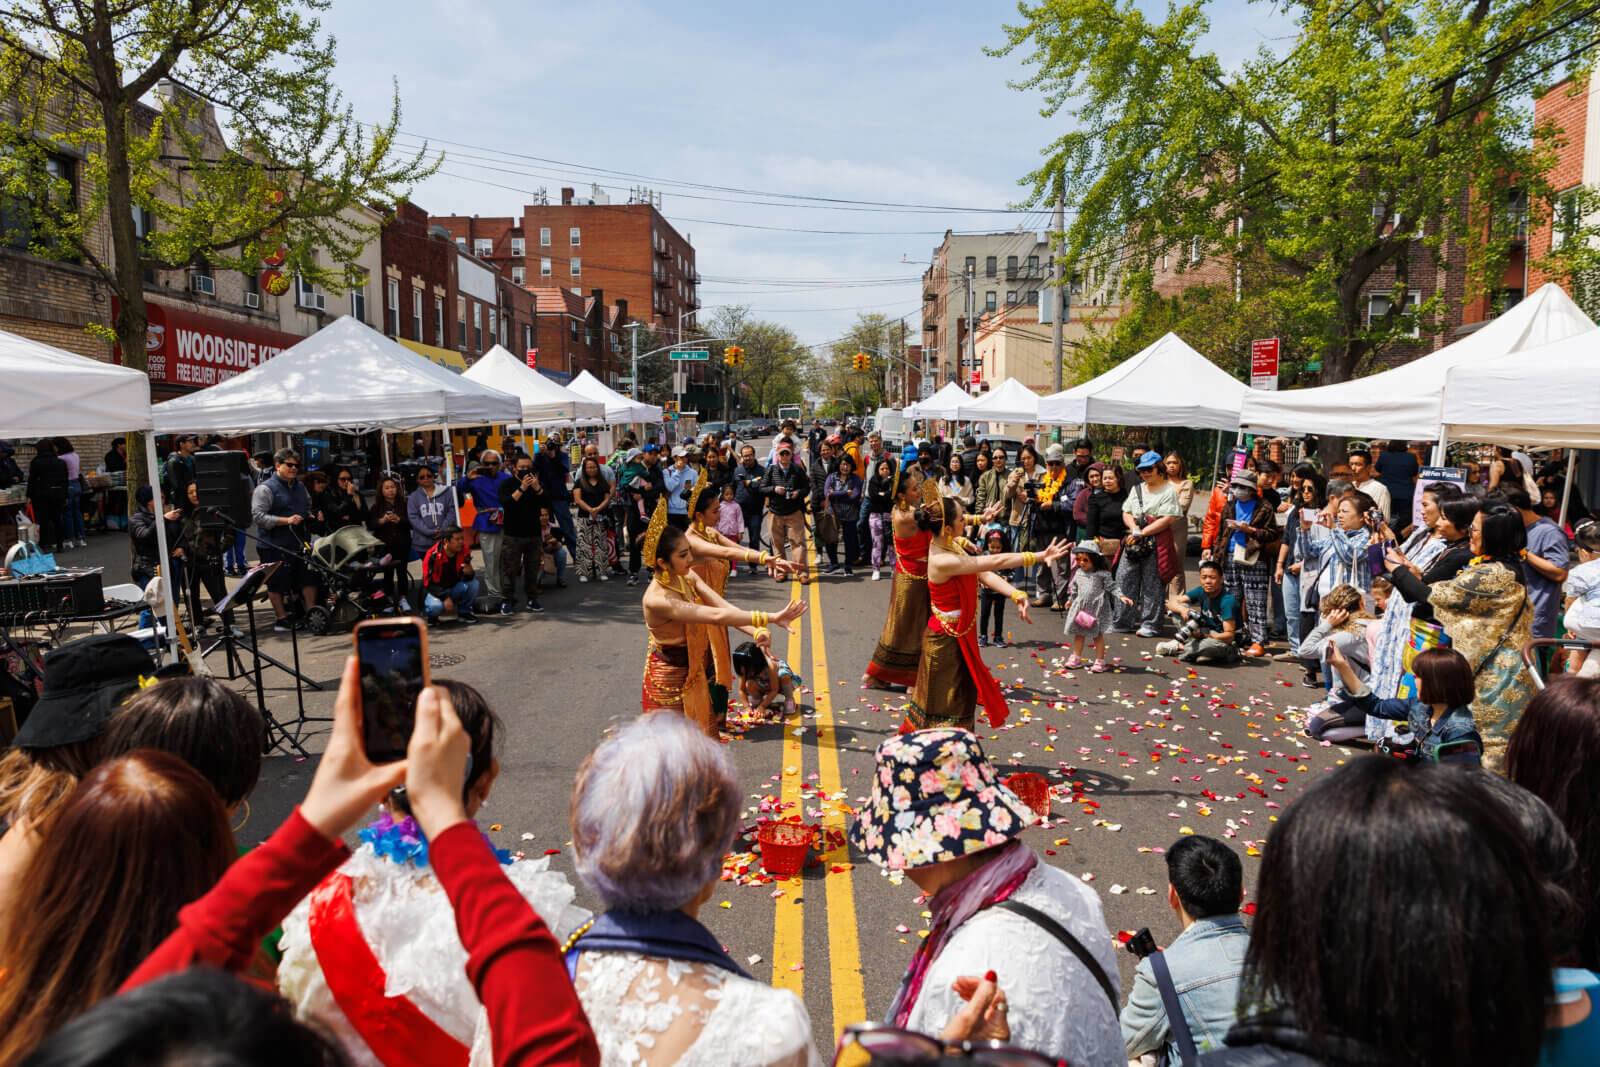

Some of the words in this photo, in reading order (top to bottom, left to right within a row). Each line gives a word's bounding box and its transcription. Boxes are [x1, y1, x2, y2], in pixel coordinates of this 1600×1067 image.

[176, 328, 256, 368] WOODSIDE
[259, 345, 287, 362] KIT
[176, 363, 191, 382] FREE
[191, 365, 216, 385] DELIVERY
